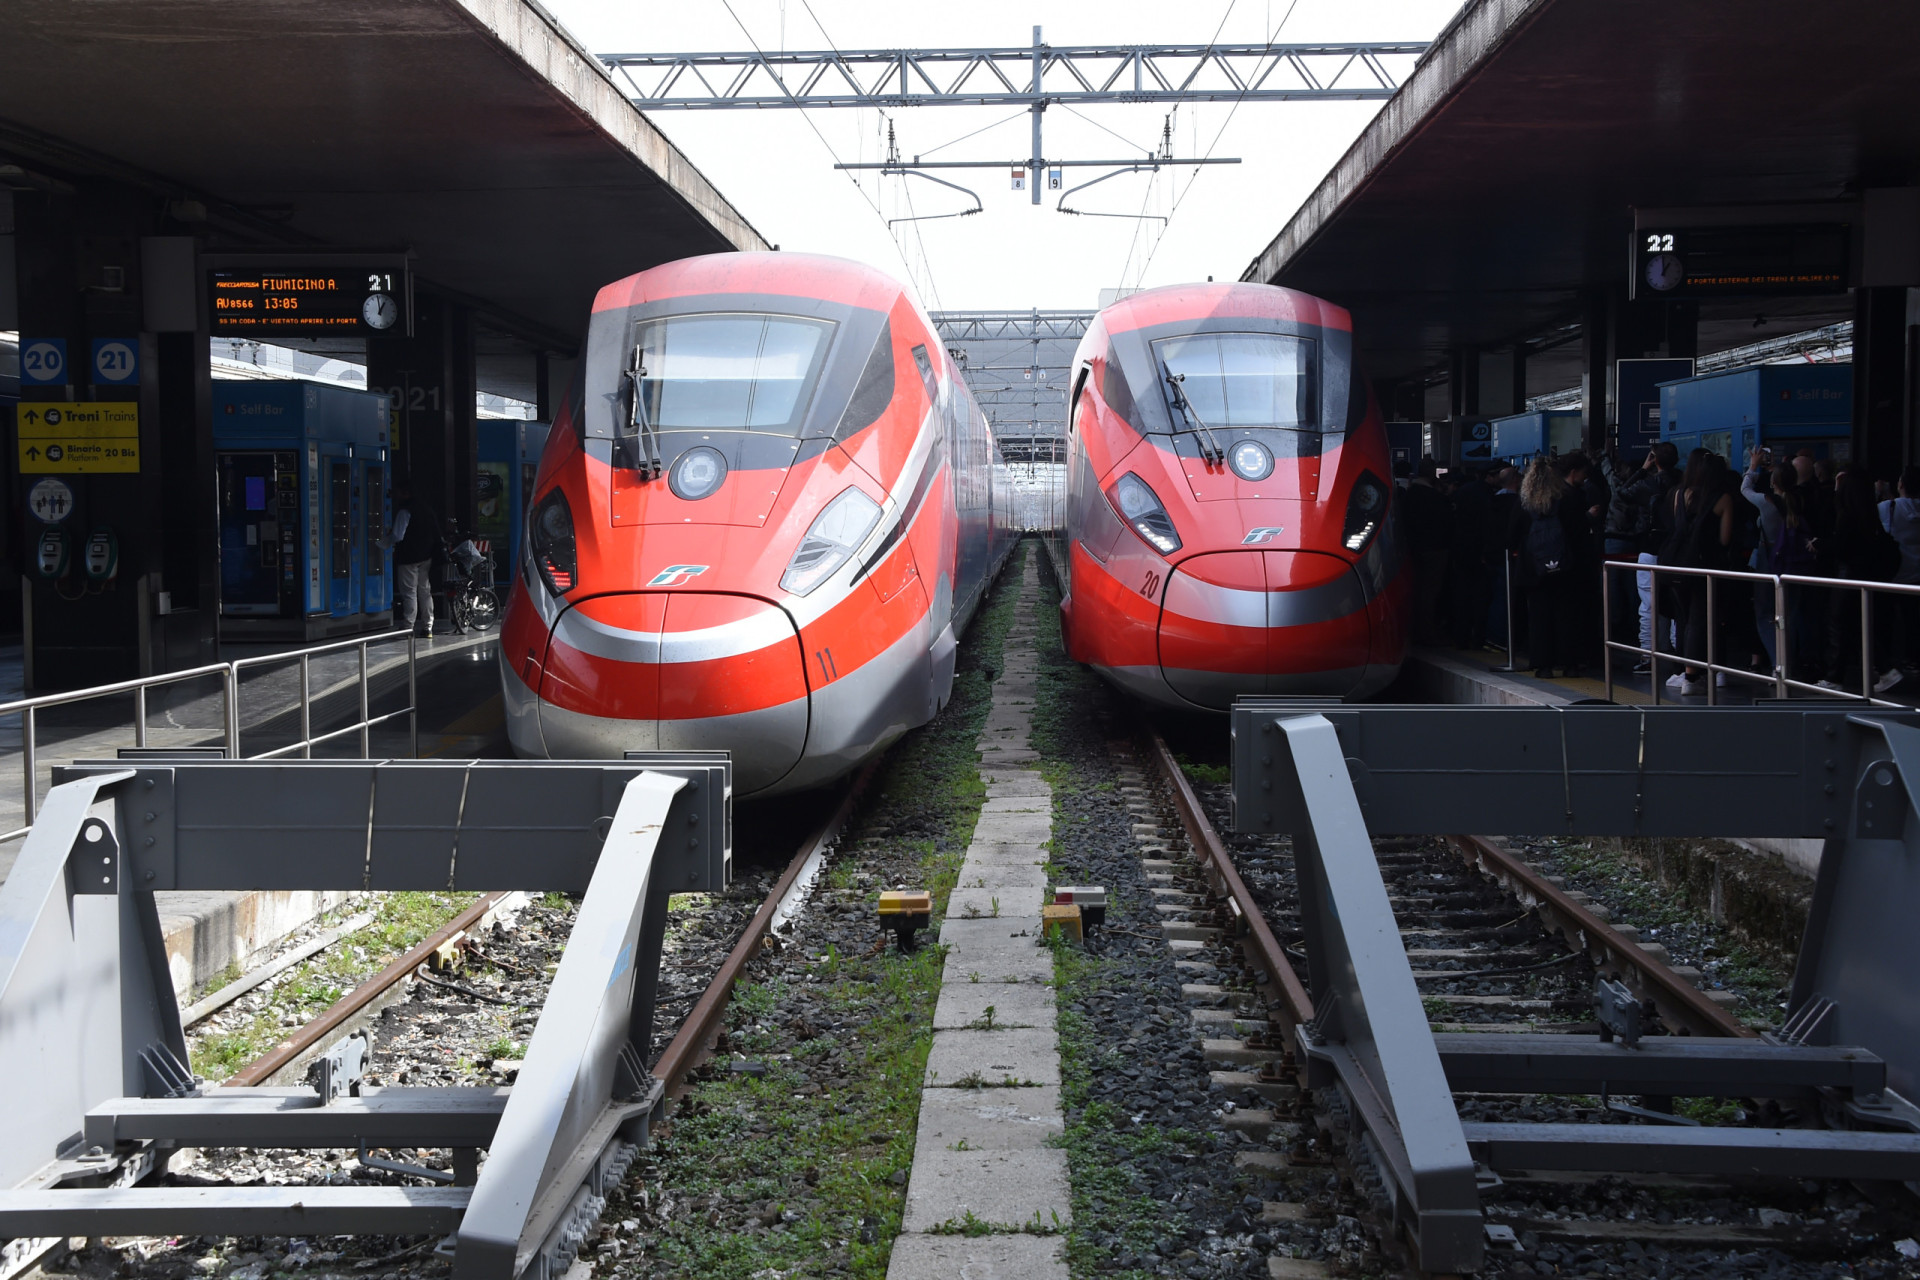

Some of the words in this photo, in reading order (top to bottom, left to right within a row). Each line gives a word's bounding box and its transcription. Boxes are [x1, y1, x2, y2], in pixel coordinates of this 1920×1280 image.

[1015, 180, 1021, 188] 8
[1052, 178, 1059, 189] 9
[1647, 234, 1674, 252] 22
[262, 279, 326, 290] FIUMICINO
[368, 274, 391, 291] 21
[264, 298, 298, 309] 13:05
[26, 350, 60, 370] 20
[101, 350, 128, 370] 21
[1797, 388, 1821, 400] Self
[1822, 388, 1845, 400] Bar
[240, 404, 262, 415] Self
[264, 404, 285, 415] Bar
[65, 410, 100, 422] Treni
[103, 410, 136, 422] Trains
[67, 445, 102, 453] Binario
[105, 449, 118, 457] 20
[121, 448, 136, 457] Bis
[67, 453, 99, 462] Platform
[1139, 570, 1160, 599] 20
[816, 647, 838, 682] 11
